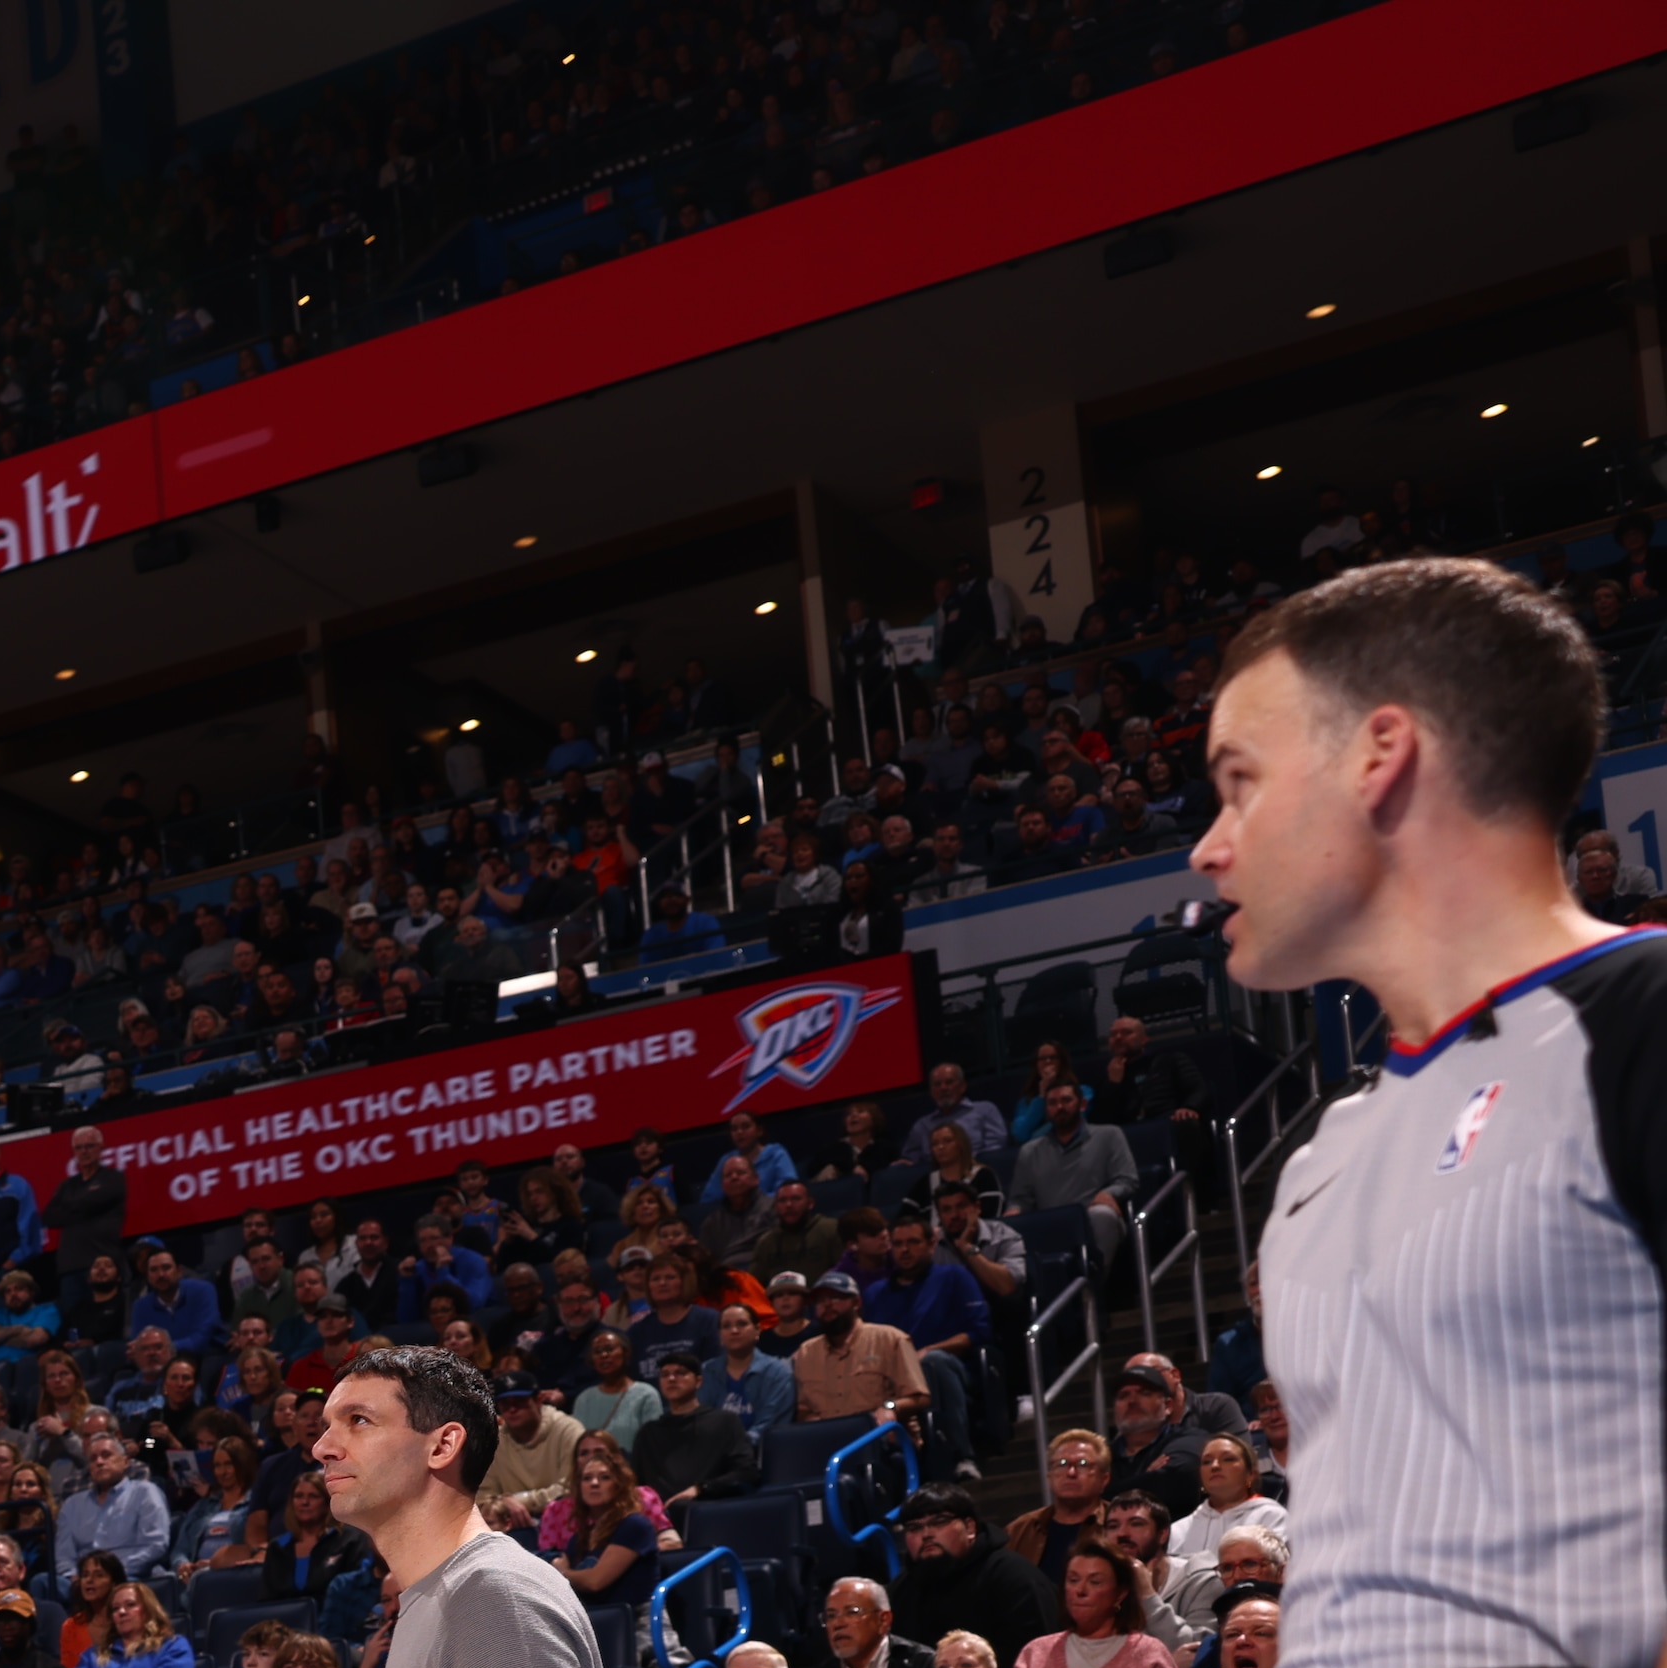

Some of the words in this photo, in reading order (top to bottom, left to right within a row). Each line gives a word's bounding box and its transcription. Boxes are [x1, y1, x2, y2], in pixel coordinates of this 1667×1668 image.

[1020, 467, 1057, 596] 224
[244, 1068, 497, 1146] HEALTHCARE
[508, 1028, 697, 1096] PARTNER
[168, 1167, 221, 1203] OF
[230, 1151, 305, 1191] THE
[313, 1132, 397, 1176] OKC
[401, 1093, 598, 1157] THUNDER
